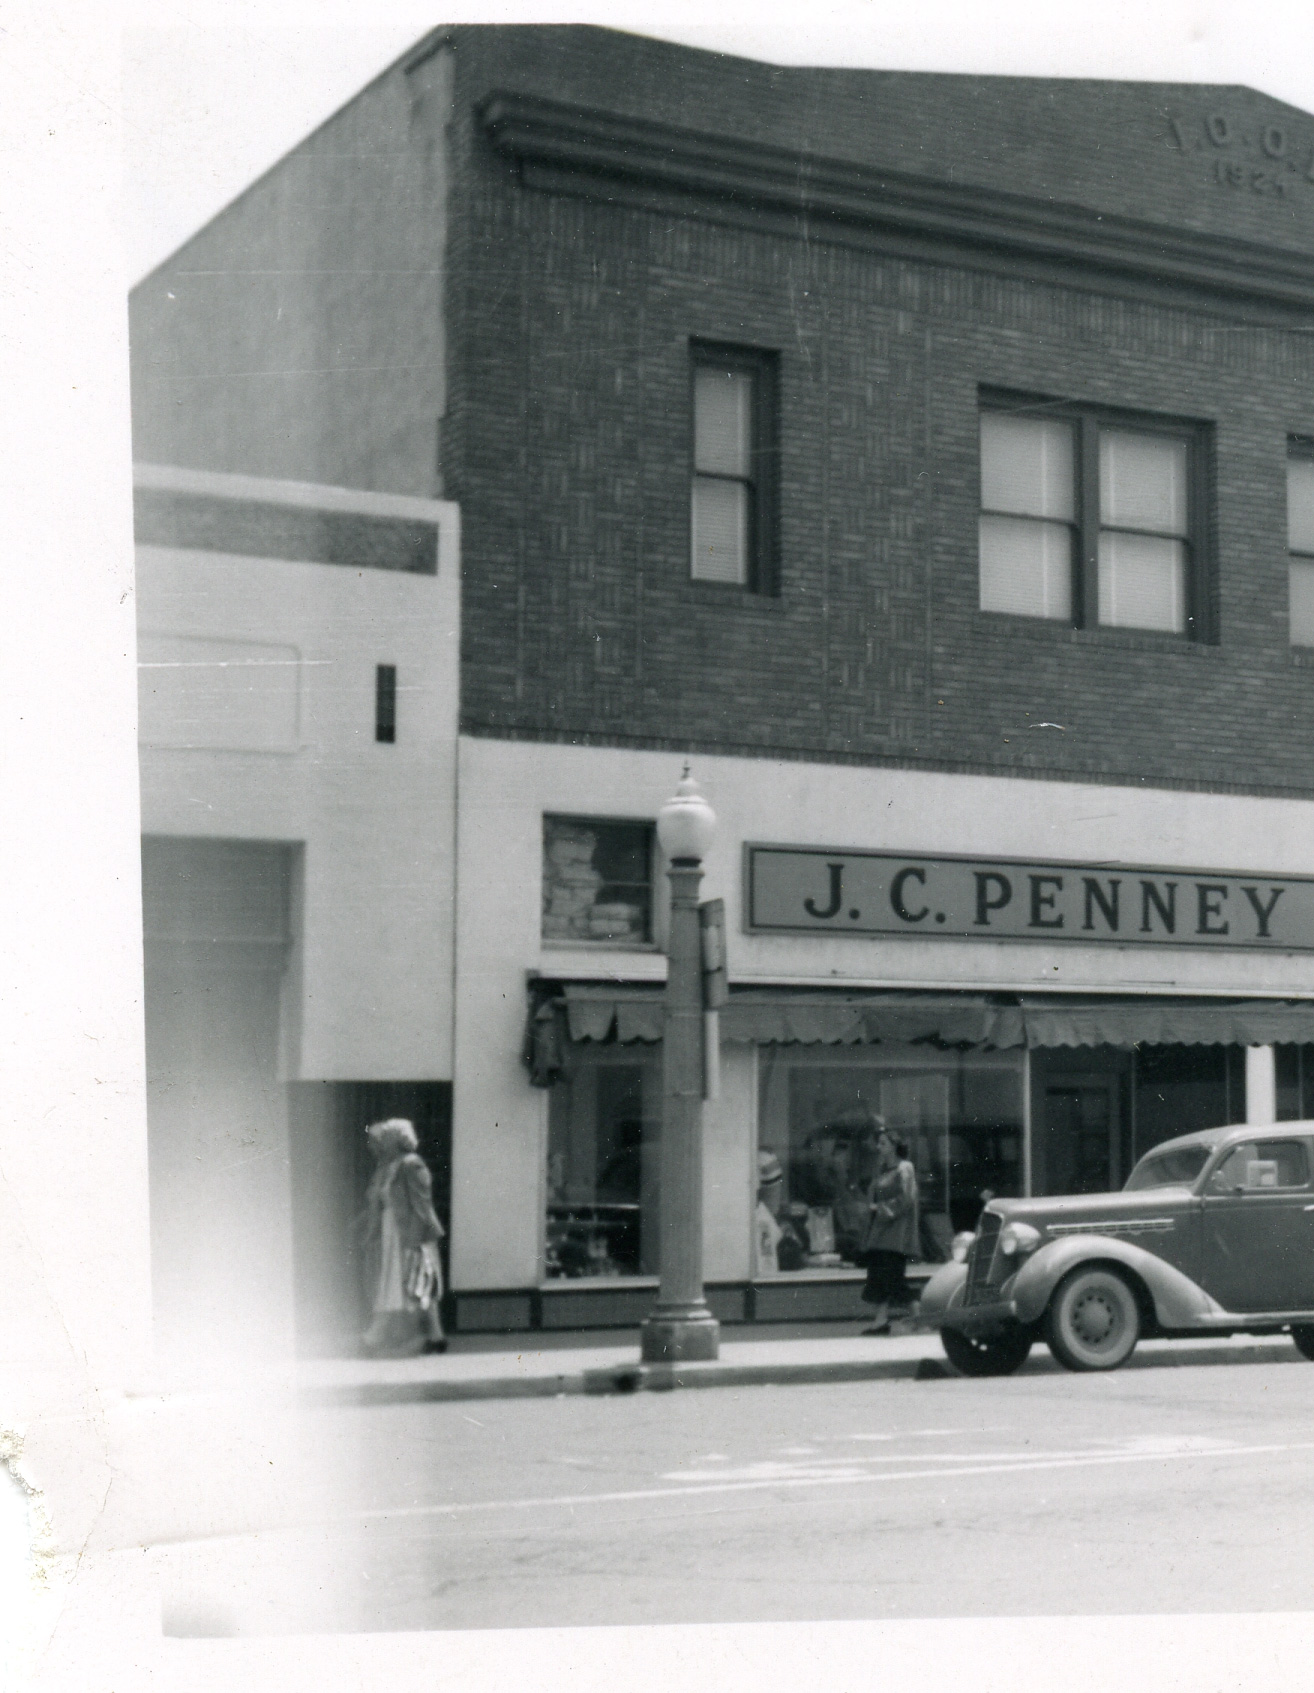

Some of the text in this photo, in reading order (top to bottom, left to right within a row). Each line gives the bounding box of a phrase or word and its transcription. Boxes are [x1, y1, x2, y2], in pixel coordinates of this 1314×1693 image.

[804, 863, 861, 920] J.
[890, 867, 947, 924] C.
[973, 871, 1285, 938] PENNEY
